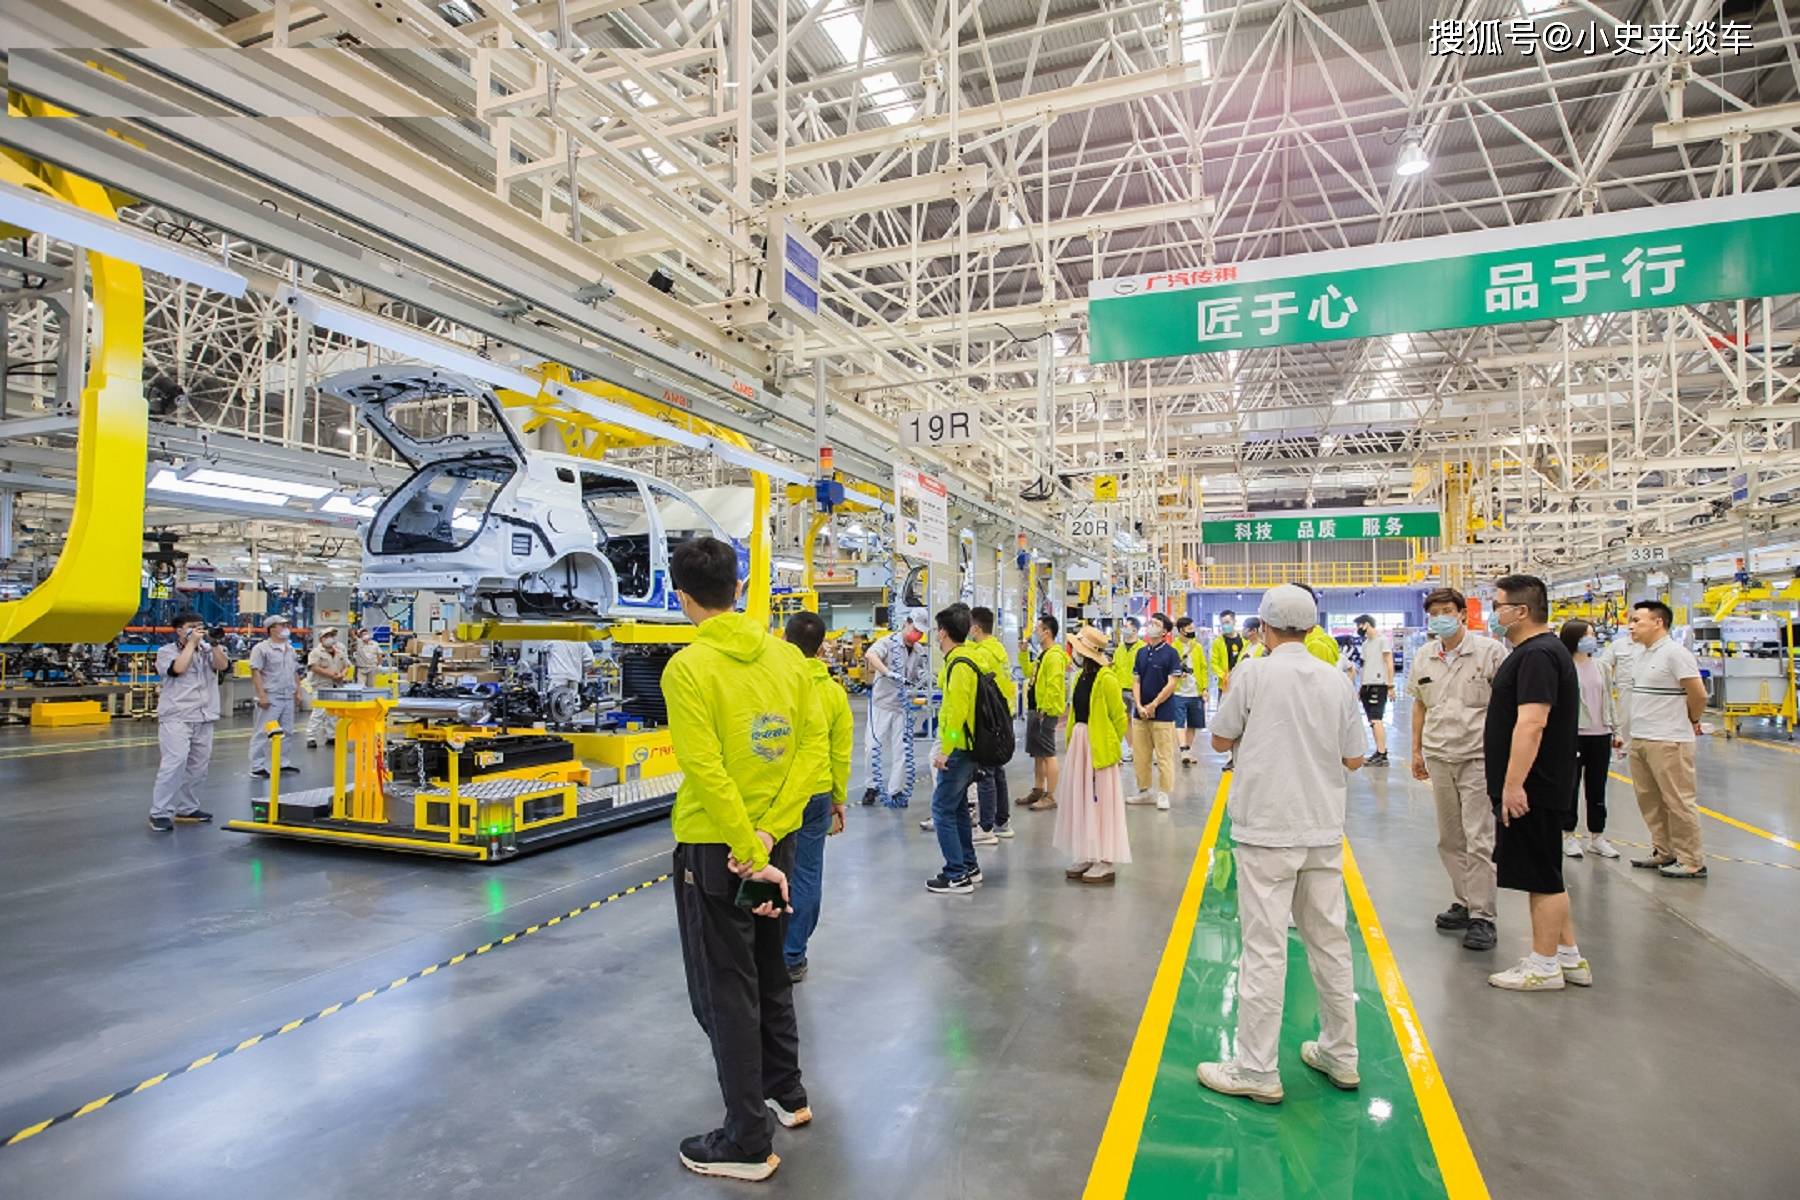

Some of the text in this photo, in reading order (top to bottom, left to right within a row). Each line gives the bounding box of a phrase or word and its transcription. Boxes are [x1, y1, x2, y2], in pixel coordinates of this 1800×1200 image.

[1197, 244, 1686, 342] 匠于心 品于行
[910, 412, 970, 443] 19R
[1071, 520, 1108, 536] 20R
[1234, 516, 1404, 541] 科技 品质 服务
[1631, 547, 1664, 561] 33R
